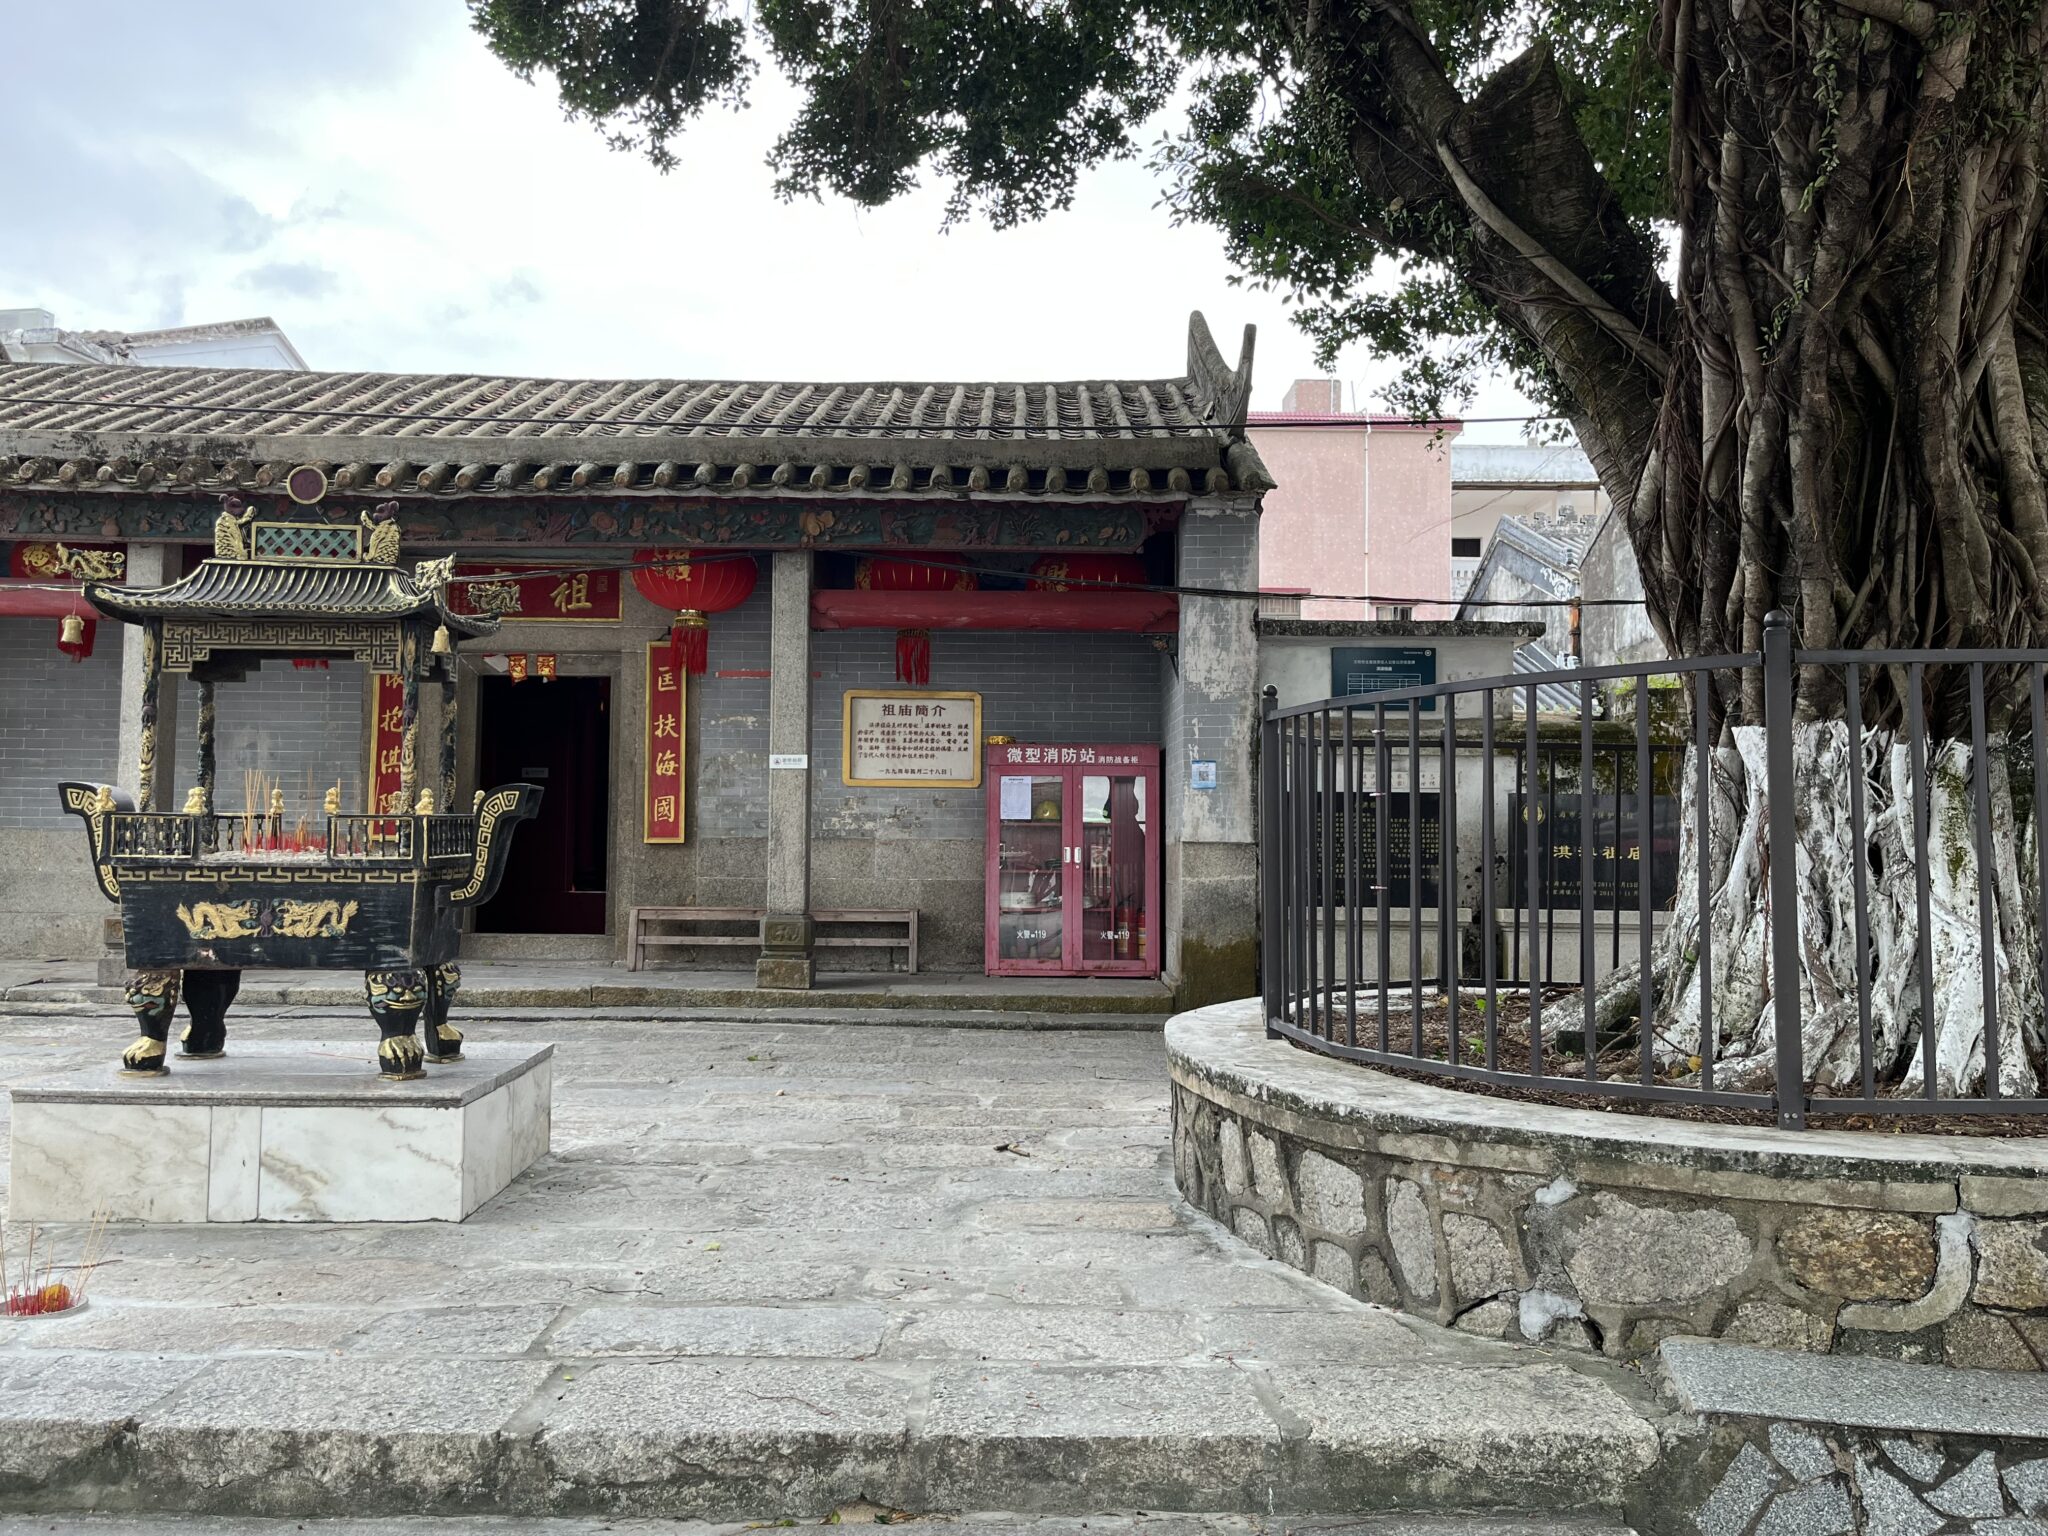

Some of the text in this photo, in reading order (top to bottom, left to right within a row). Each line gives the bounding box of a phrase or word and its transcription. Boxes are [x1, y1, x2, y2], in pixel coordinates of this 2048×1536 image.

[653, 666, 680, 822] 匡扶海國
[1007, 747, 1139, 764] 微型消防站 消防战备柜
